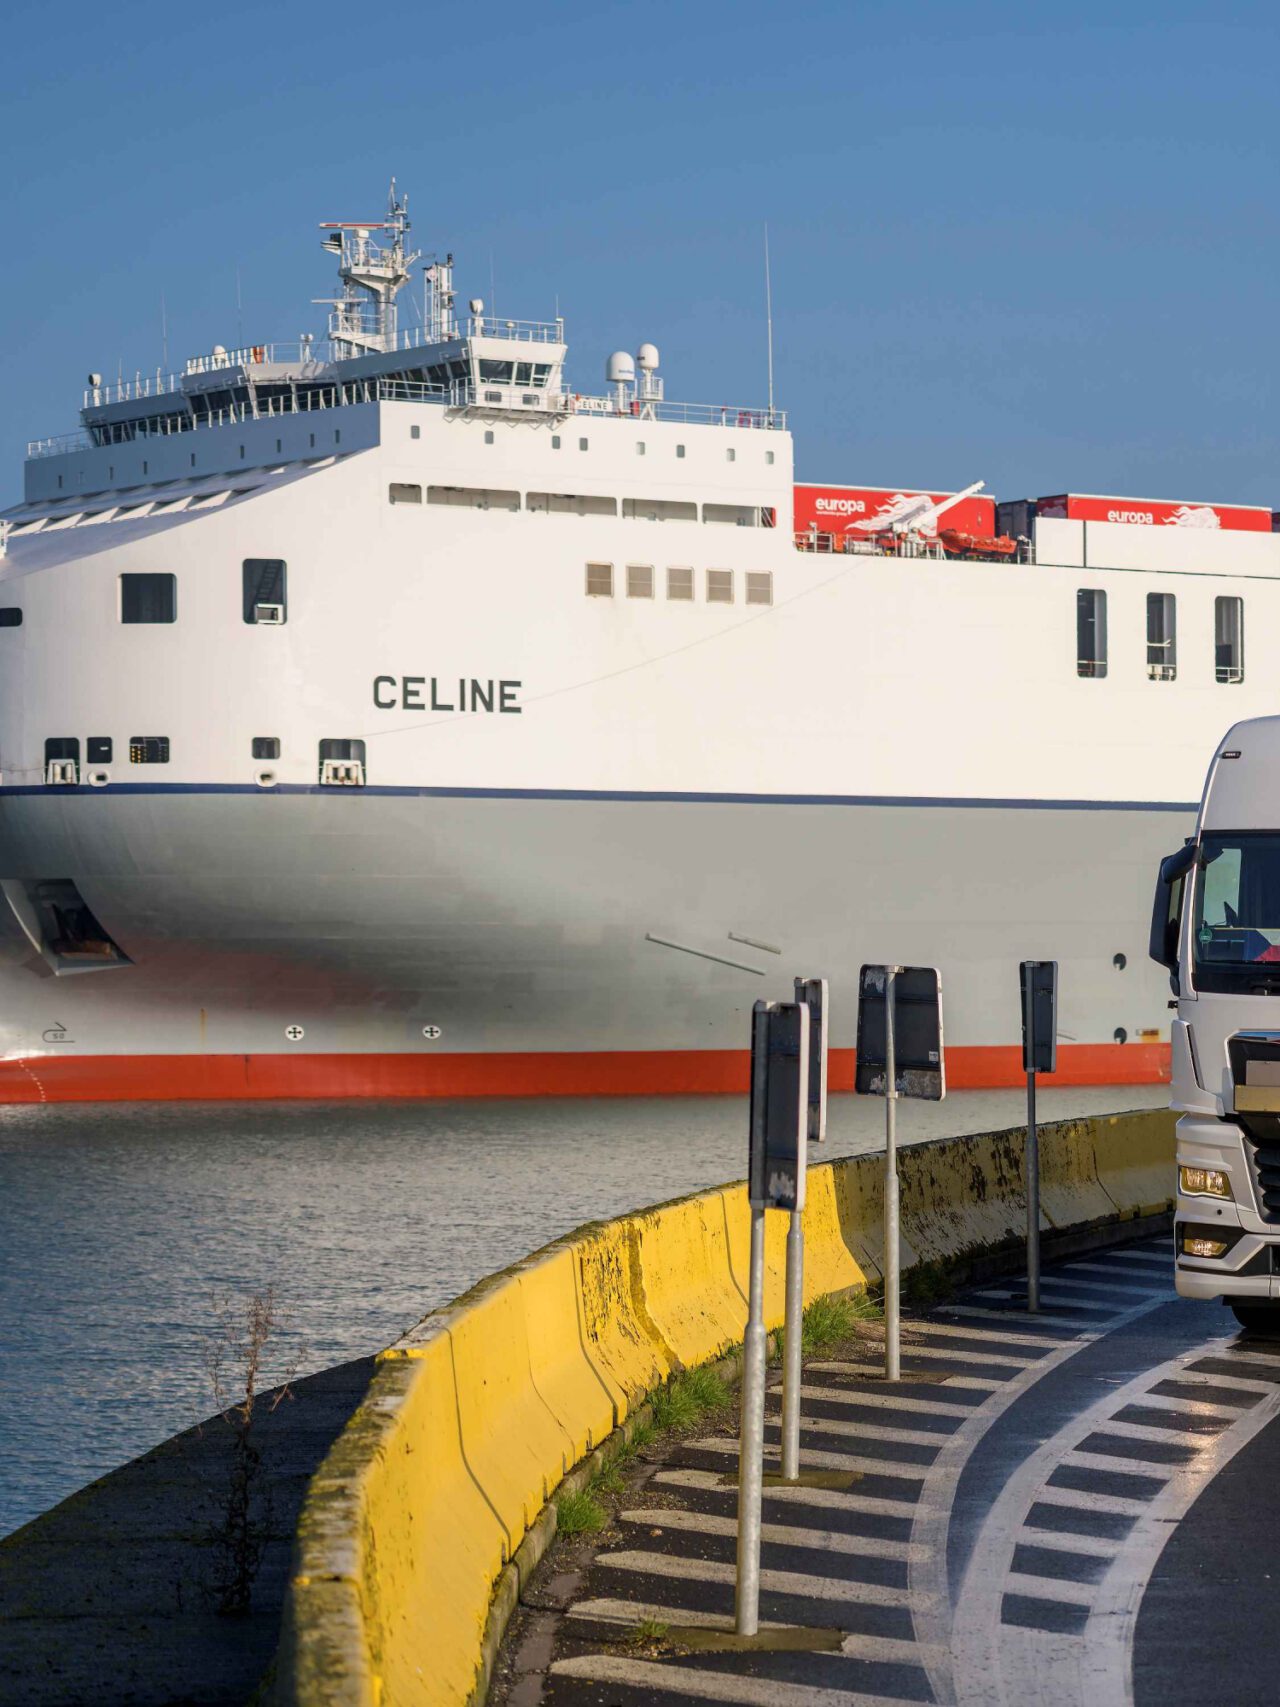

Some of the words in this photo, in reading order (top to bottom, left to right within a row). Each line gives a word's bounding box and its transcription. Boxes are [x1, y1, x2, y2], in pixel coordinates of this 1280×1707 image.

[815, 498, 866, 515] europa
[1107, 510, 1154, 524] europa
[373, 675, 522, 714] CELINE
